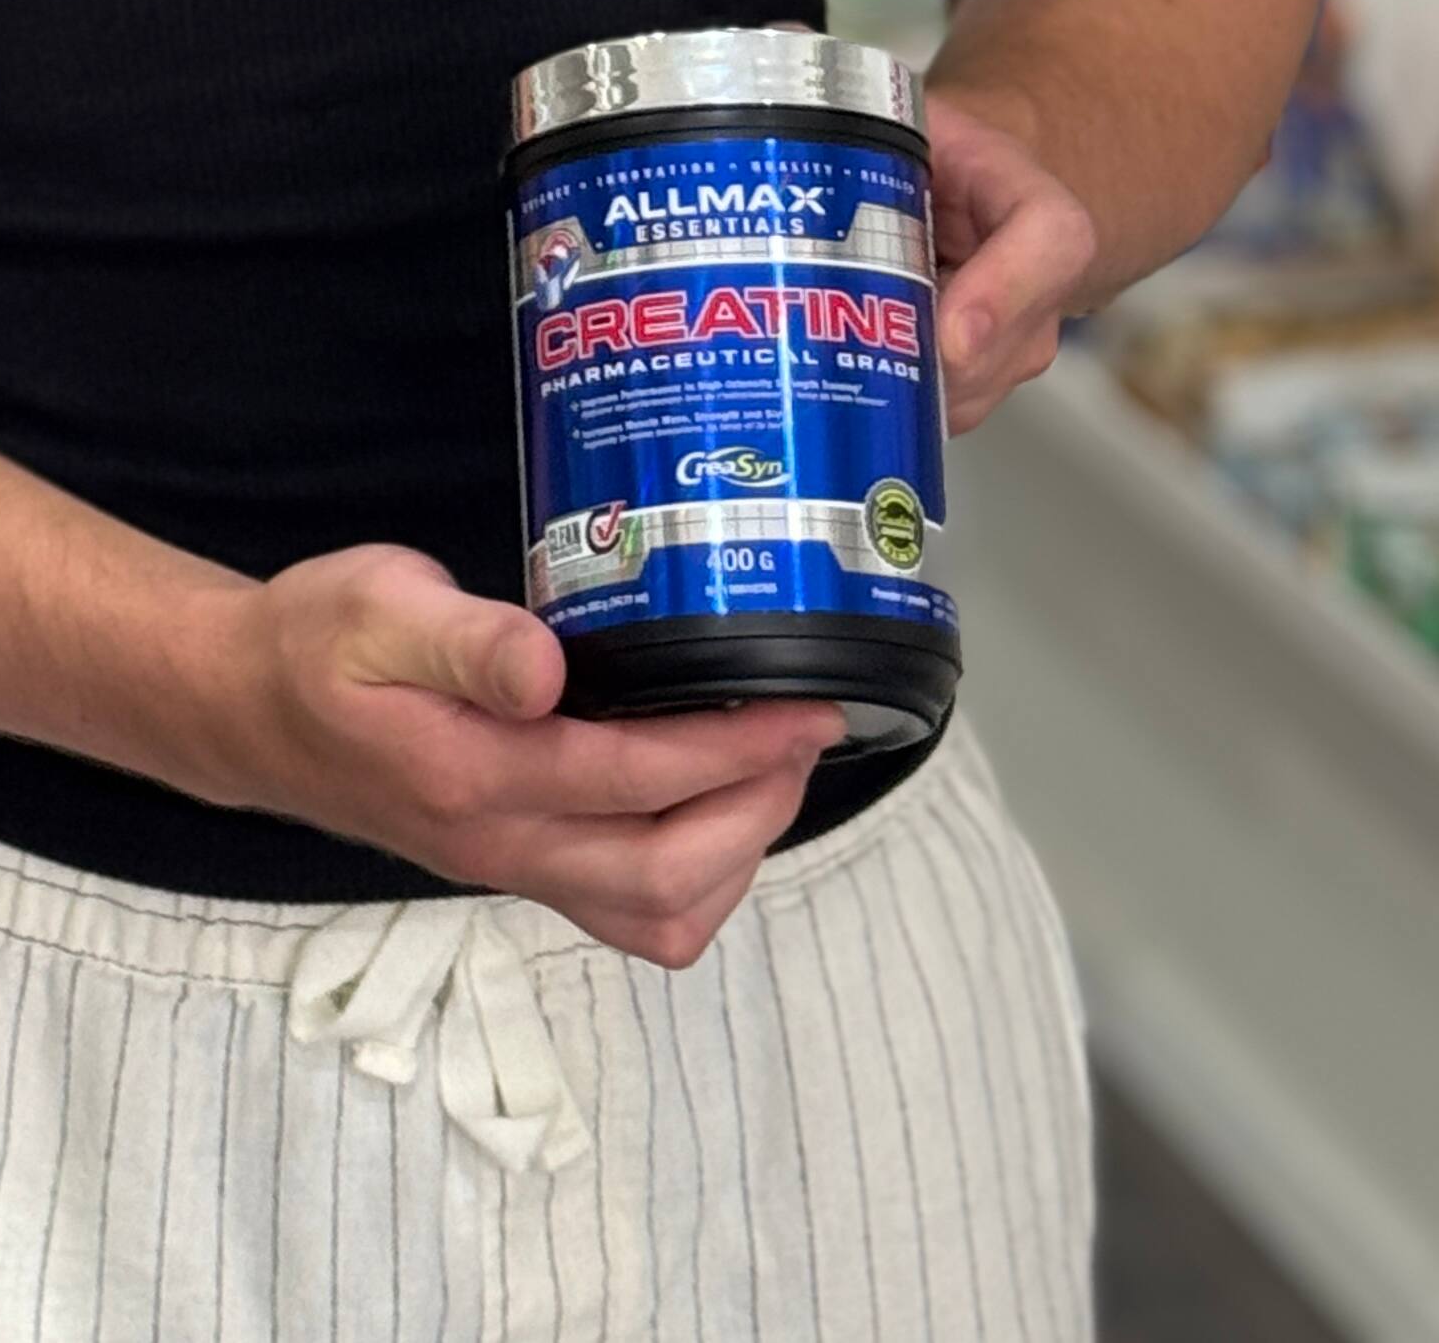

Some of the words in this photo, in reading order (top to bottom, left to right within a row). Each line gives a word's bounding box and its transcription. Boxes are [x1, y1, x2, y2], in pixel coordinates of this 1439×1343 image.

[603, 183, 827, 227] ALLMAX
[634, 216, 805, 243] ESSENTIALS
[536, 286, 921, 372] CREATINE
[540, 348, 819, 399] PHARMACEUTICAL
[836, 351, 921, 382] GRADE
[706, 547, 755, 572] 400
[759, 550, 776, 571] G
